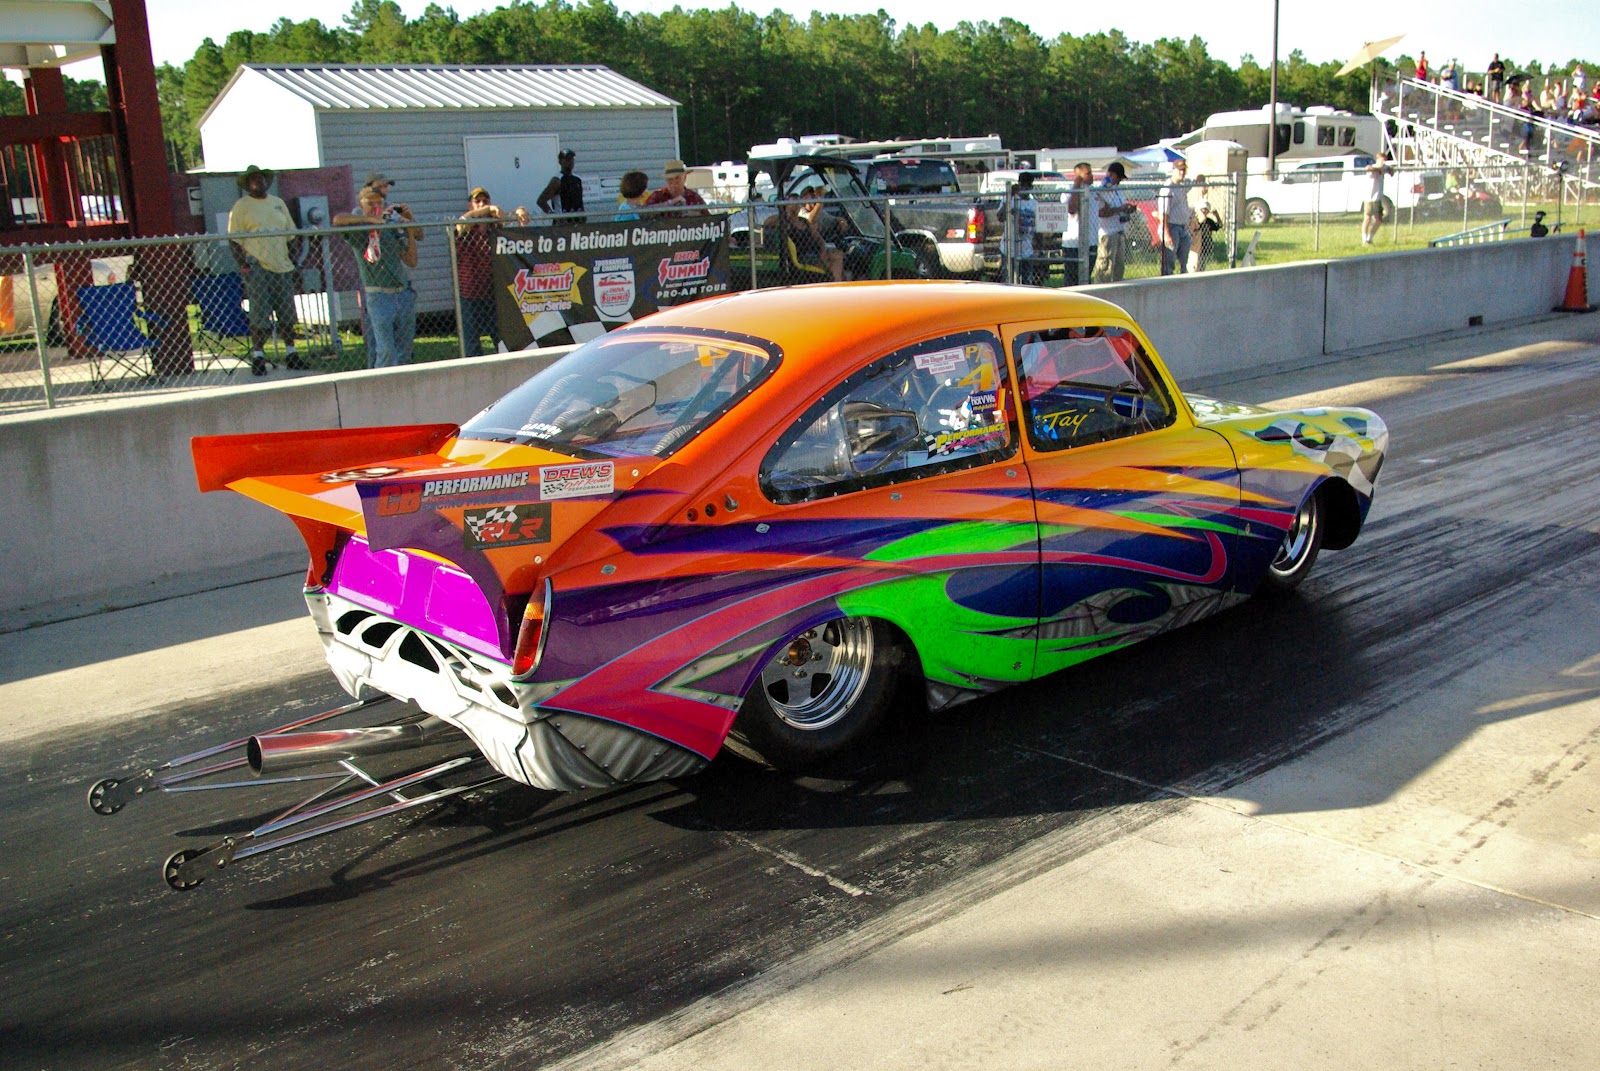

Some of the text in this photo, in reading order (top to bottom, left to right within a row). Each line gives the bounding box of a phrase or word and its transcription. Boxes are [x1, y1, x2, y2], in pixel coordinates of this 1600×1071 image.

[496, 221, 725, 255] Race to a National Championship!
[595, 258, 629, 267] TOURNAMENT
[674, 250, 700, 262] IHRA
[533, 262, 562, 274] IHRA
[601, 263, 632, 272] CHAMPIONS
[658, 257, 710, 287] SUMMIT
[514, 268, 574, 300] SUMMIT
[656, 283, 727, 299] PRO-AM TOUR
[520, 300, 572, 315] SuperSeries
[957, 363, 993, 391] 4
[936, 423, 1006, 449] PERFORMANCE
[543, 463, 612, 483] DREW'S
[563, 479, 584, 490] Off
[568, 484, 611, 492] PERFORMANCE
[376, 471, 529, 517] CB PERFORMANCE
[480, 518, 544, 543] RLR
